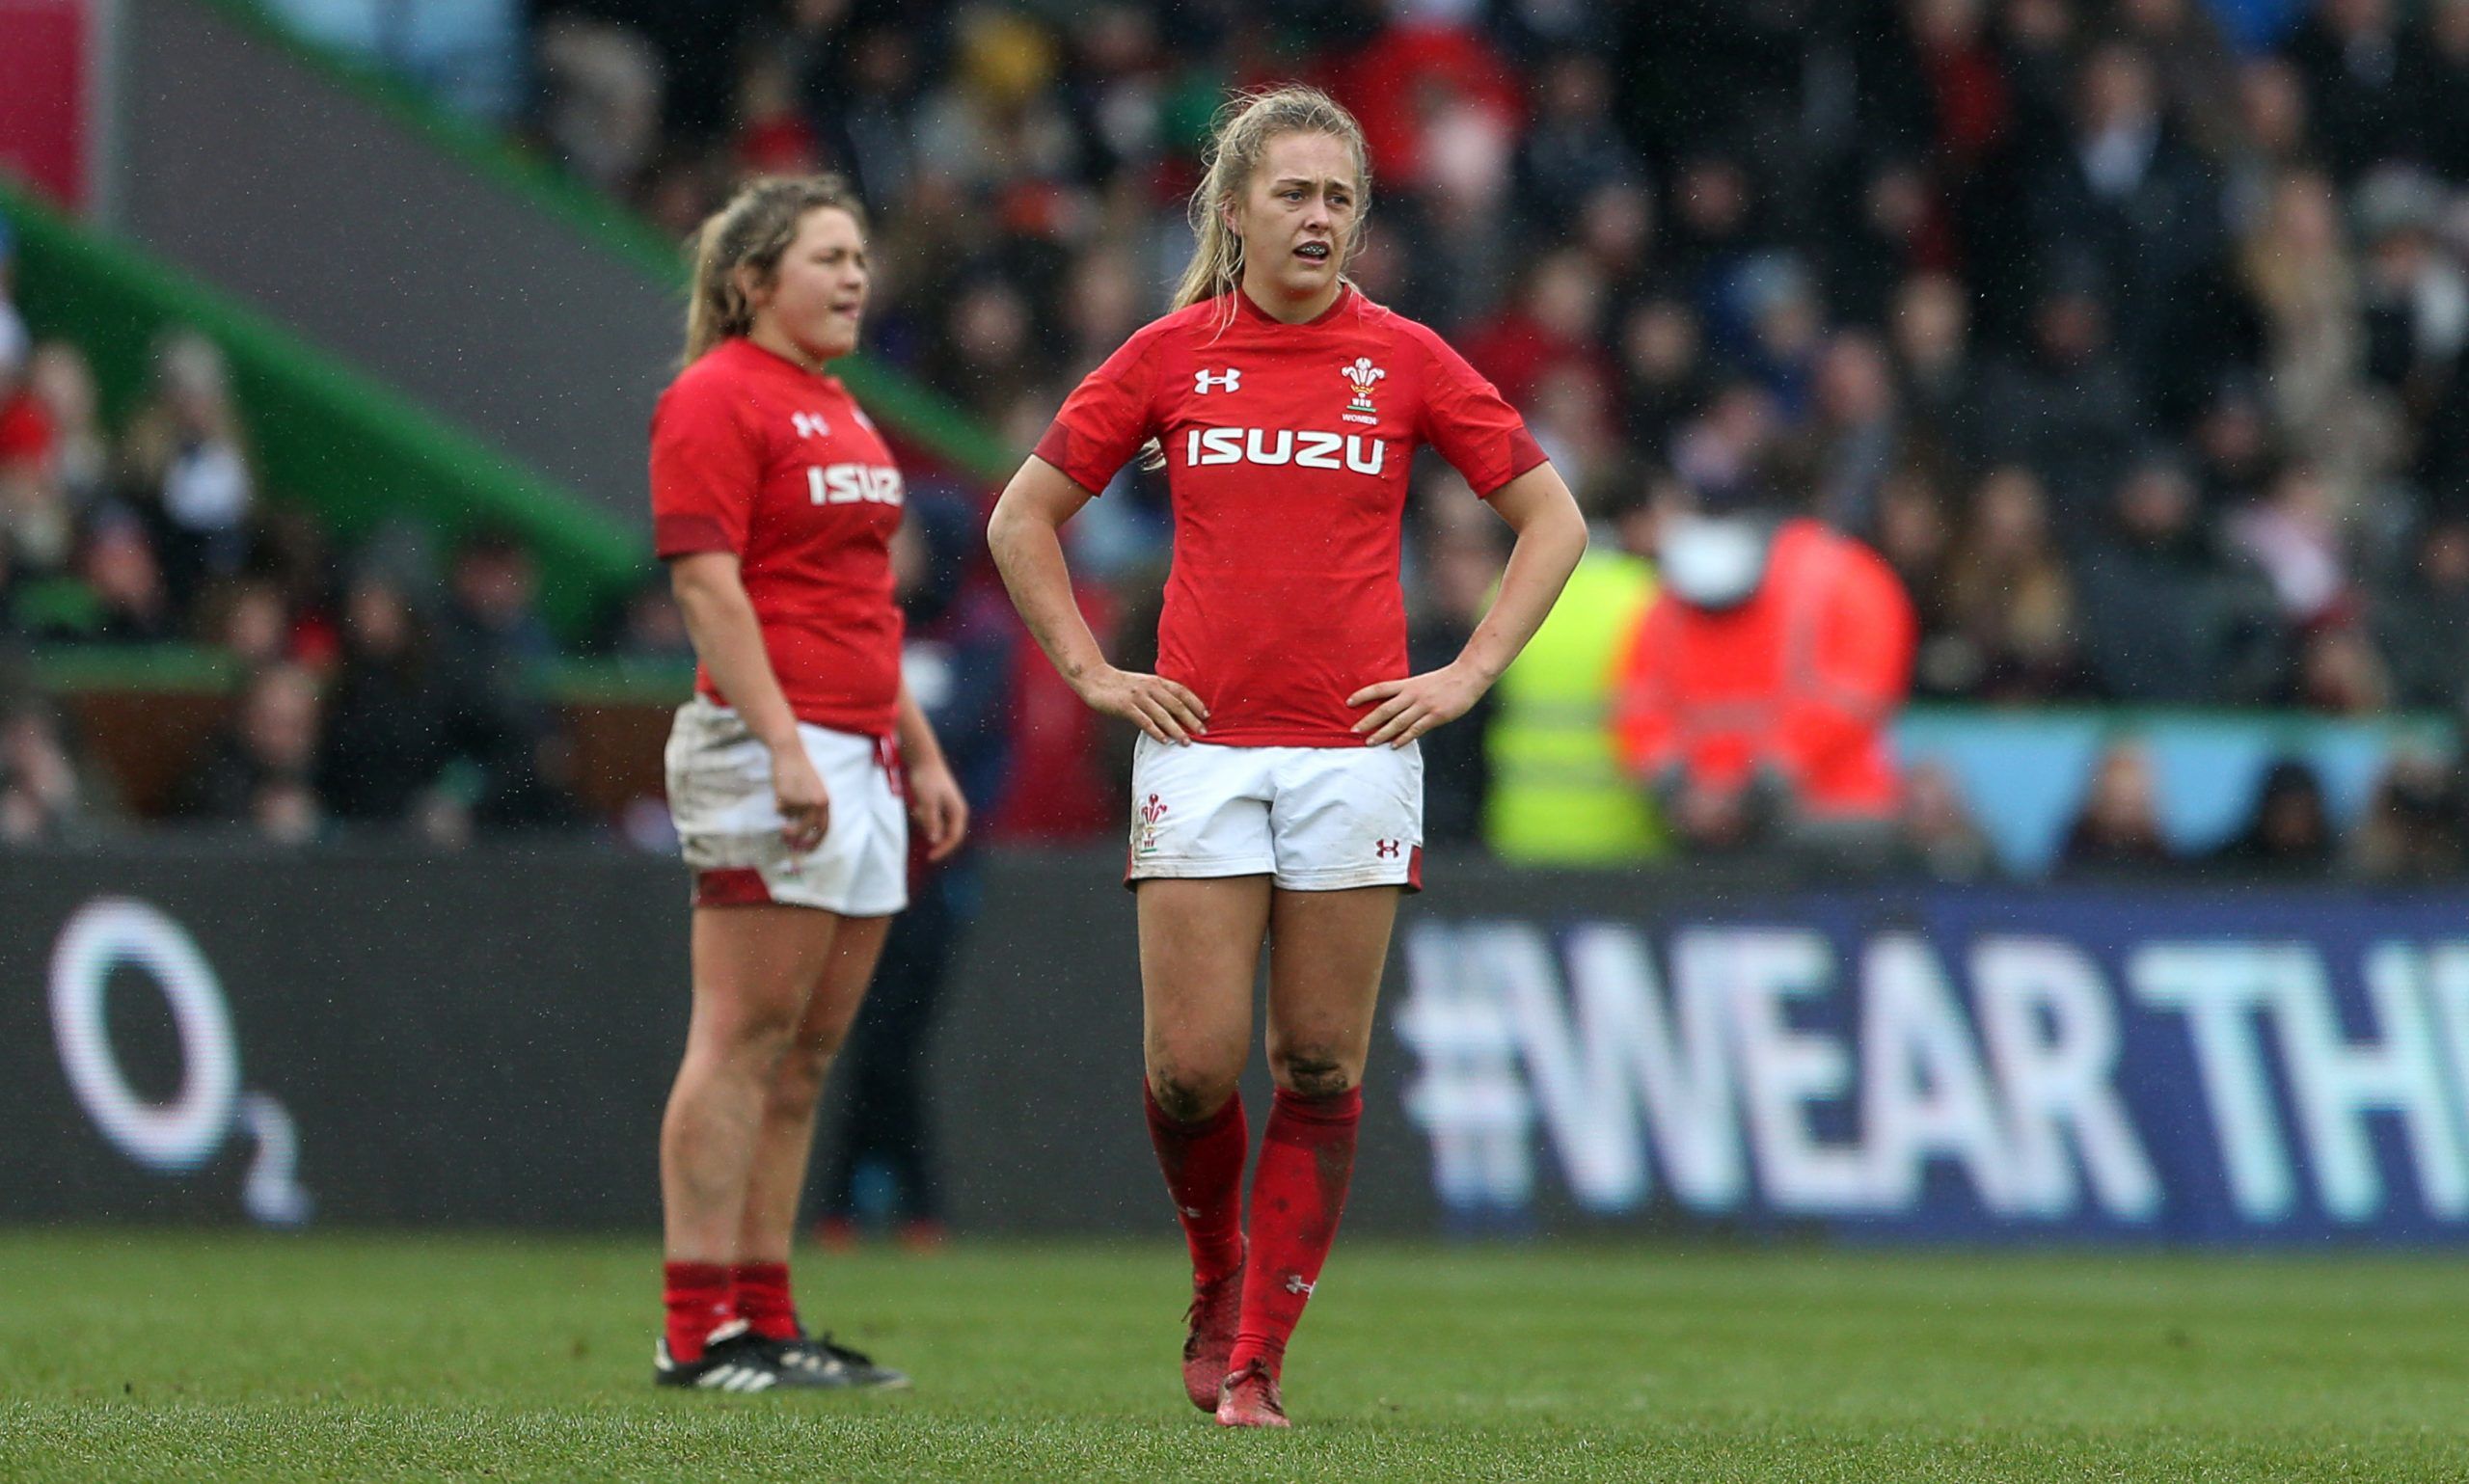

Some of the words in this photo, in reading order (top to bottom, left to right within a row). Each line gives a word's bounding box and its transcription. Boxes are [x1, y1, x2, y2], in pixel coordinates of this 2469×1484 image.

[1342, 413, 1377, 425] WOMEN
[1187, 427, 1385, 475] ISUZU
[1398, 921, 2158, 1223] #WEAR
